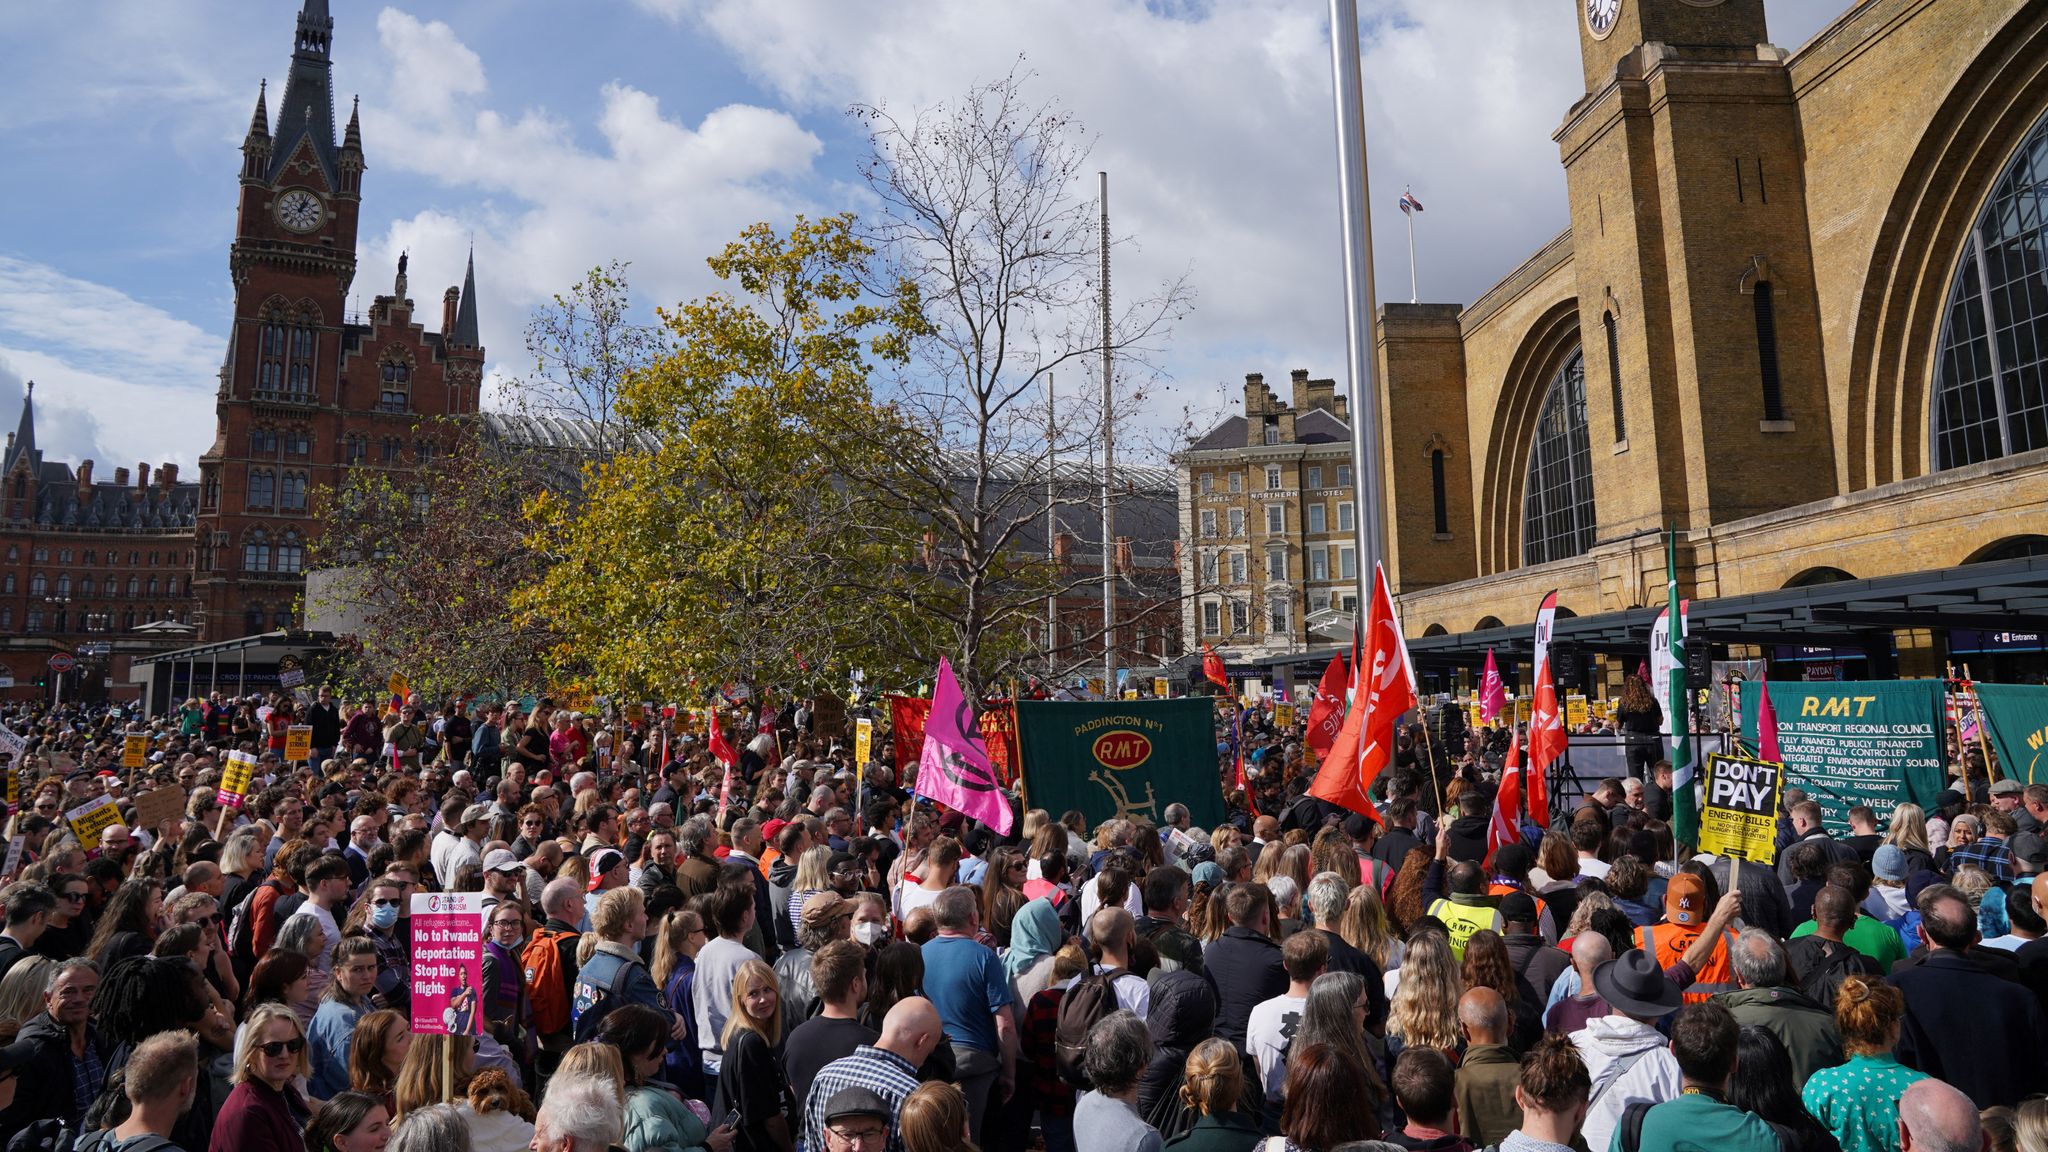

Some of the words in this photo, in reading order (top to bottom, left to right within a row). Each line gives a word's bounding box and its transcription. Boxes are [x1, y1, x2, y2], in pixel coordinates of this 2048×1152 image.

[1251, 491, 1299, 499] NORTHERN
[1537, 619, 1548, 644] jvl
[2011, 633, 2038, 641] Entrance
[1655, 630, 1669, 651] jv
[1806, 665, 1833, 676] PAYDAY
[1801, 696, 1876, 717] RMT
[1074, 715, 1141, 737] PADDINGTON
[1797, 723, 1841, 733] TRANSPORT
[1845, 724, 1890, 734] REGIONAL
[1892, 724, 1933, 734] COUNCIL
[1778, 736, 1799, 744] FULLY
[1801, 737, 1836, 746] FINANCED
[1839, 739, 1872, 748] PUBLICLY
[1877, 740, 1923, 748] FINANCED
[1100, 739, 1144, 760] RMT
[1784, 744, 1848, 756] DEMOCRATICALLY
[1851, 748, 1907, 757] CONTROLLED
[1780, 754, 1824, 764] INTEGRATED
[1827, 756, 1901, 767] ENVIRONMENTALLY
[1907, 759, 1940, 768] SOUND
[1715, 760, 1775, 785] DON'T
[1792, 764, 1818, 773] PUBLIC
[1825, 766, 1886, 777] TRANSPORT
[1786, 777, 1806, 785] AFETY
[1811, 779, 1847, 788] EQUALITY
[1853, 783, 1899, 791] SOLIDARITY
[1712, 778, 1772, 810] PAY
[1862, 798, 1896, 808] WEEK
[77, 807, 112, 826] Migrants
[1708, 810, 1744, 822] ENERGY
[1746, 816, 1770, 826] BILLS
[1745, 831, 1766, 839] WINTER
[423, 918, 445, 928] refugees
[1452, 922, 1475, 933] RMT
[415, 929, 429, 942] No
[431, 929, 441, 942] to
[443, 929, 479, 942] Rwanda
[415, 947, 475, 962] deportations
[415, 964, 438, 979] Stop
[440, 964, 455, 977] the
[415, 981, 446, 997] flights
